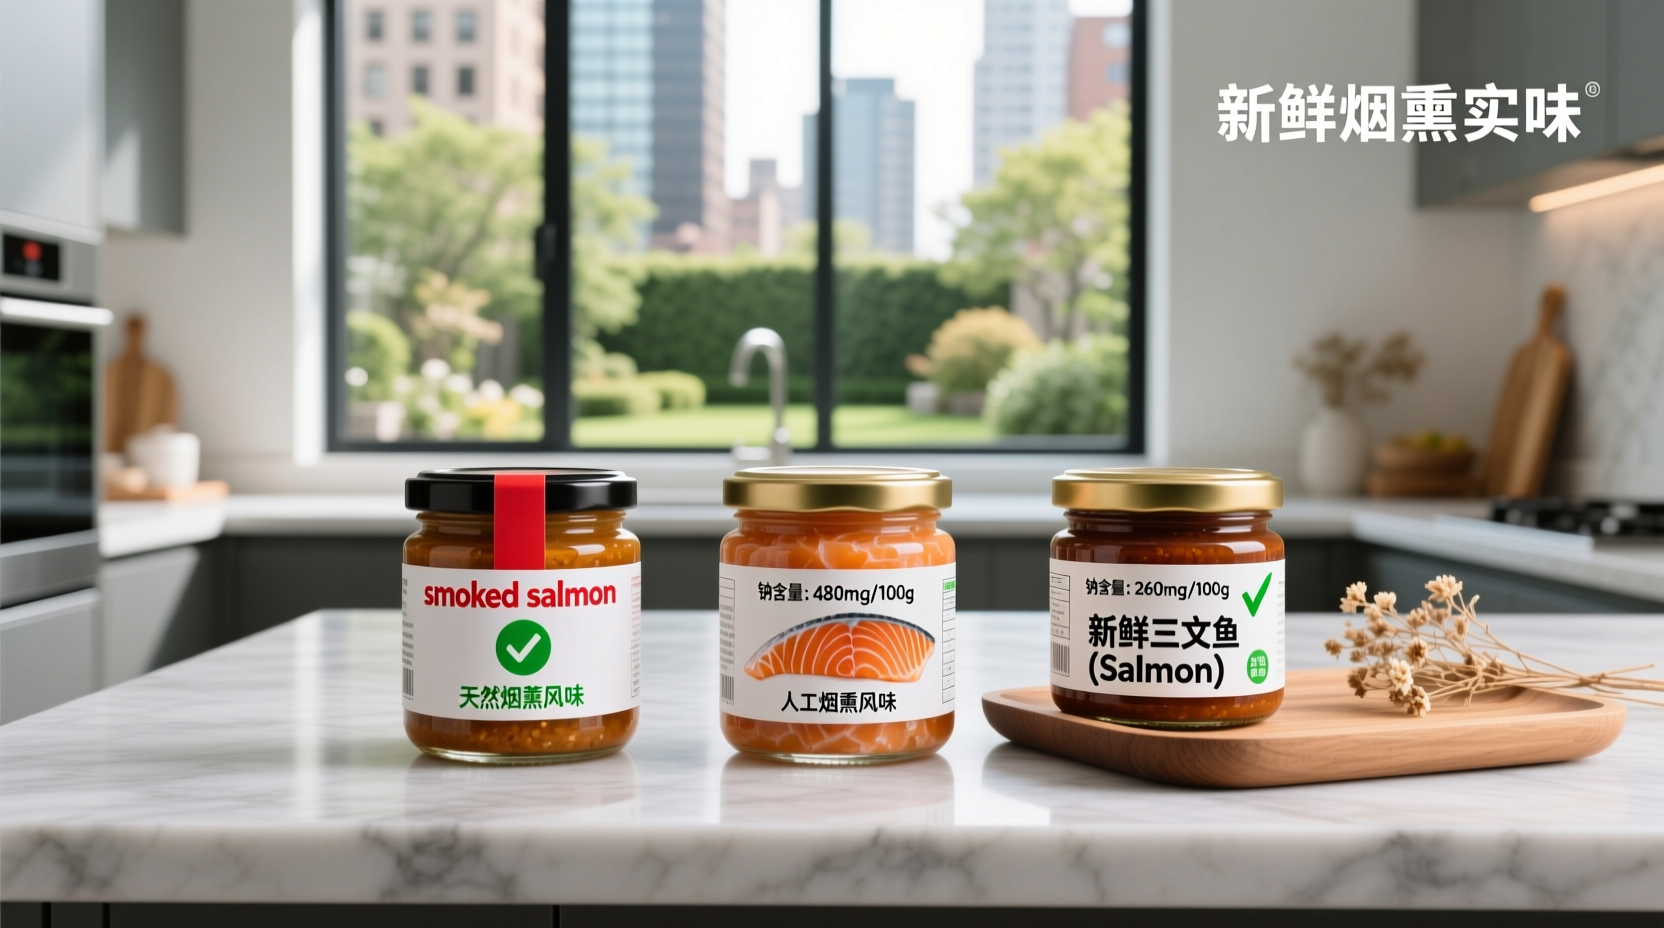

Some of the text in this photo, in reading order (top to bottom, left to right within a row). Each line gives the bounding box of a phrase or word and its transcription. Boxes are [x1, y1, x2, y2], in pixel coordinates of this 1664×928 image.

[424, 579, 617, 608] smoked salmon
[813, 583, 915, 606] 480mg/100g
[1135, 580, 1230, 601] 260mg/100g
[1088, 613, 1240, 650] 新鲜三文鱼
[1089, 651, 1225, 690] (Salmon)
[781, 691, 897, 714] 人工烟熏风味
